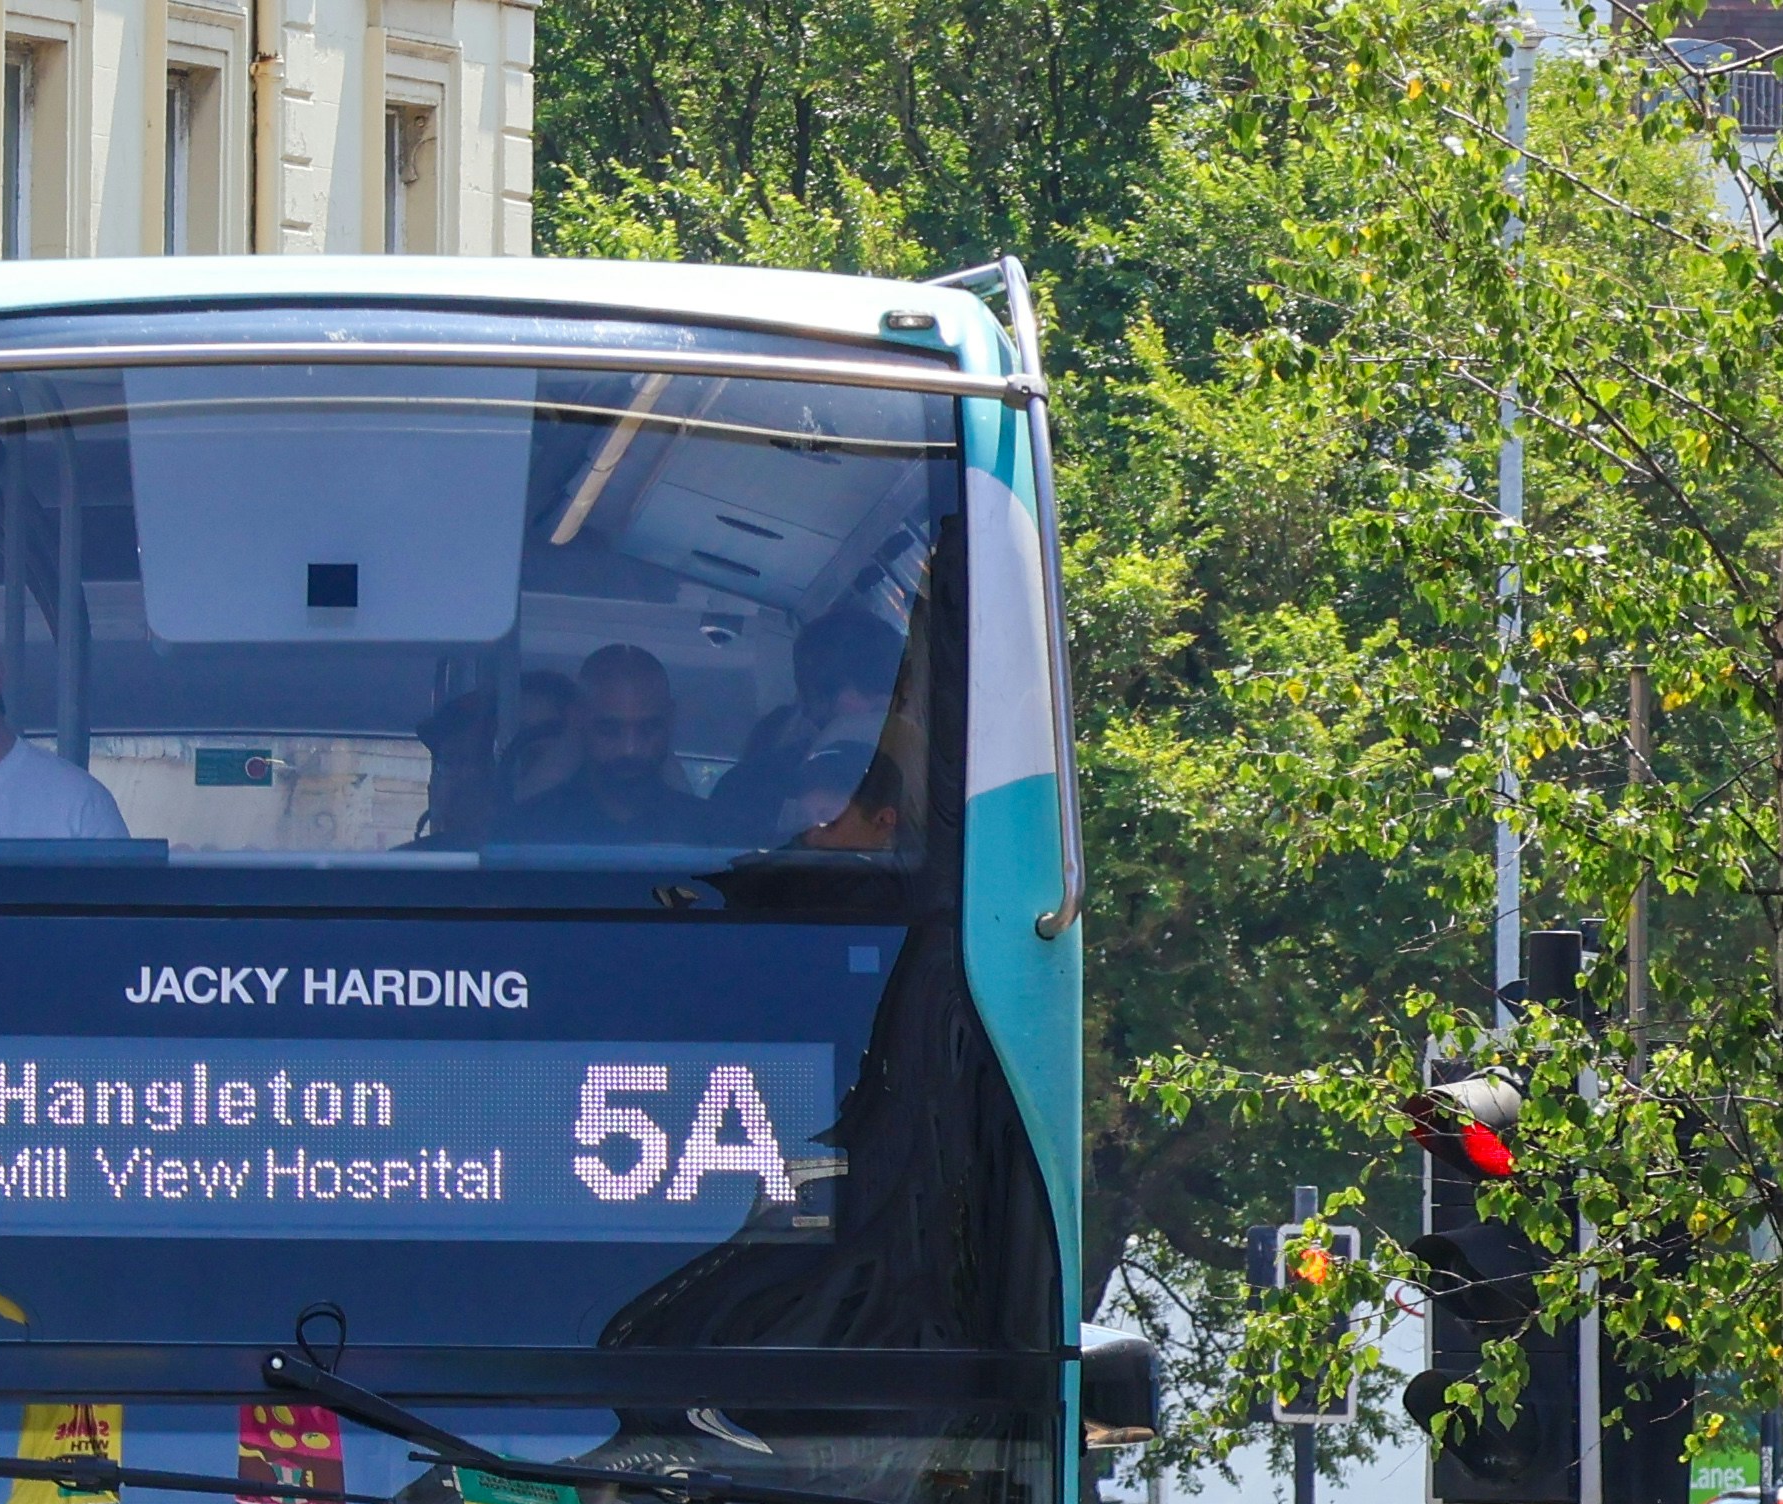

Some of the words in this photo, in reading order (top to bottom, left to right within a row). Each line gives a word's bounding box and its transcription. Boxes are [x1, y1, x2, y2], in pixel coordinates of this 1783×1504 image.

[125, 965, 288, 1004] JACKY
[304, 968, 528, 1009] HARDING
[574, 1065, 797, 1201] 5A
[95, 1146, 251, 1200] View
[265, 1147, 503, 1200] Hospital
